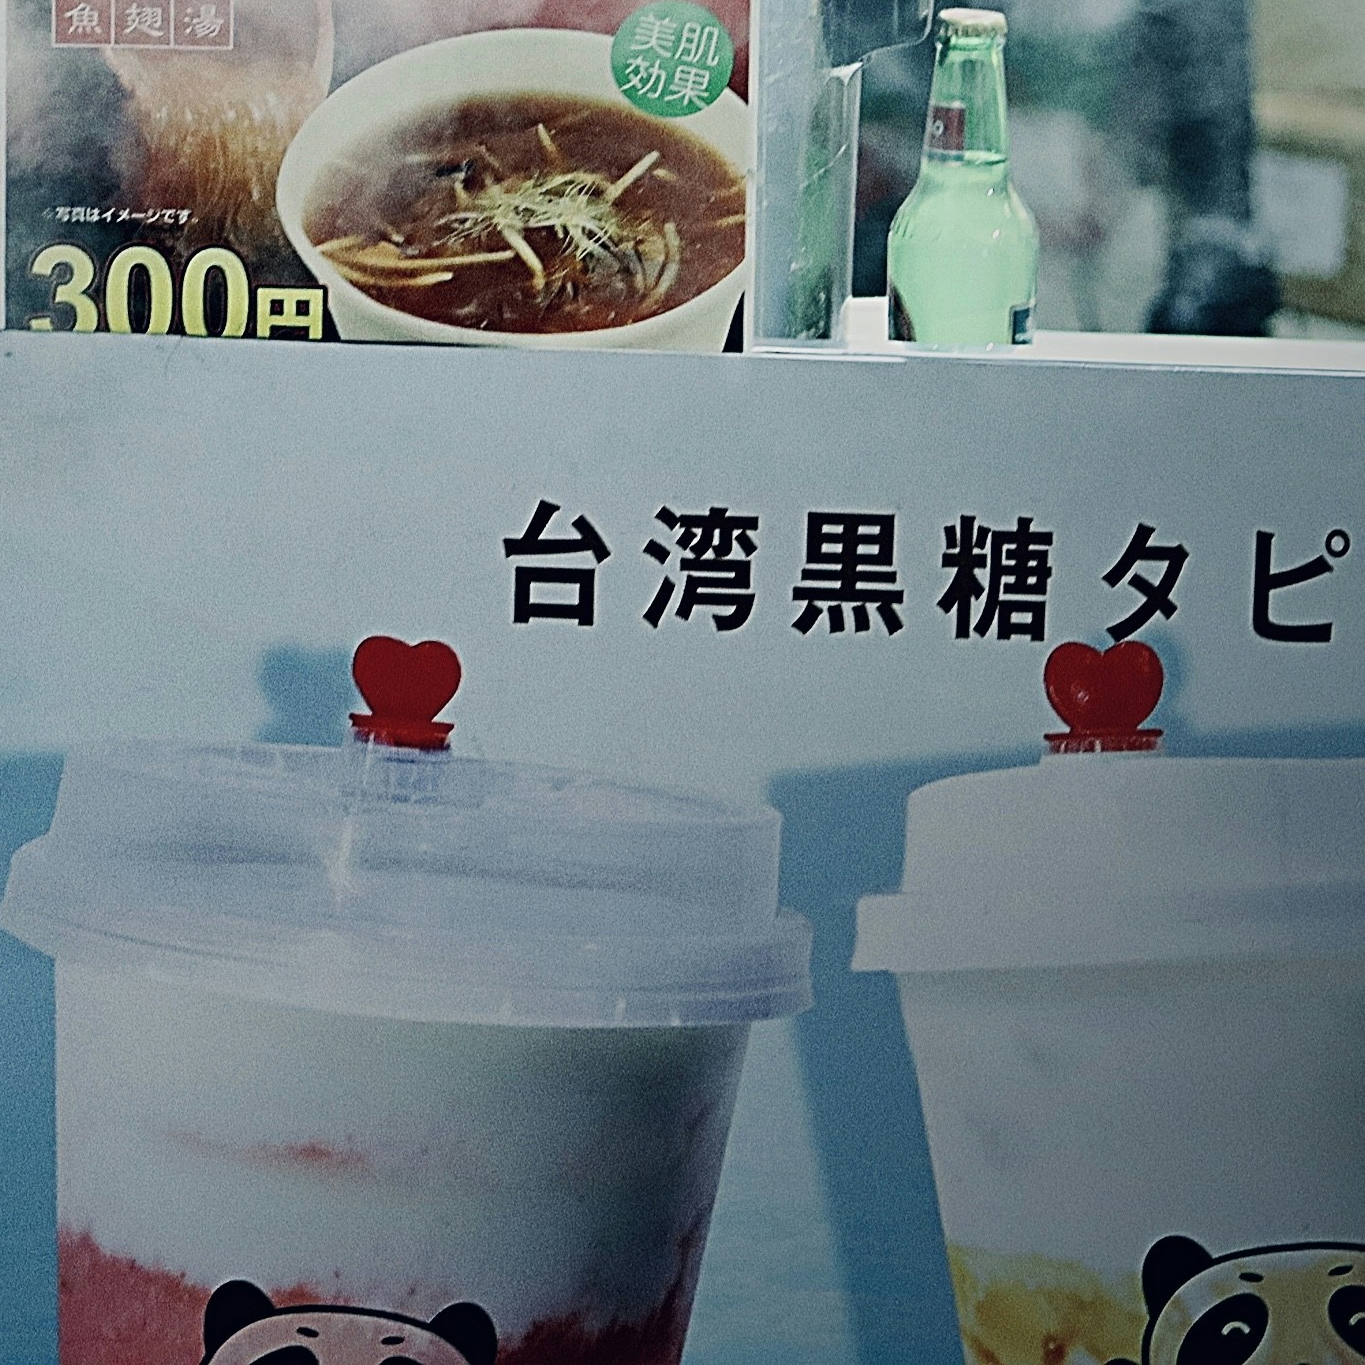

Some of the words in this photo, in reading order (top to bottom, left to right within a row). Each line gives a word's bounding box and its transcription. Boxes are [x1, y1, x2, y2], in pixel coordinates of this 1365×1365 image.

[630, 14, 720, 67] 美肌
[619, 55, 711, 109] 効果
[28, 243, 324, 340] 300円
[503, 499, 1351, 644] 台湾黒糖タピ
